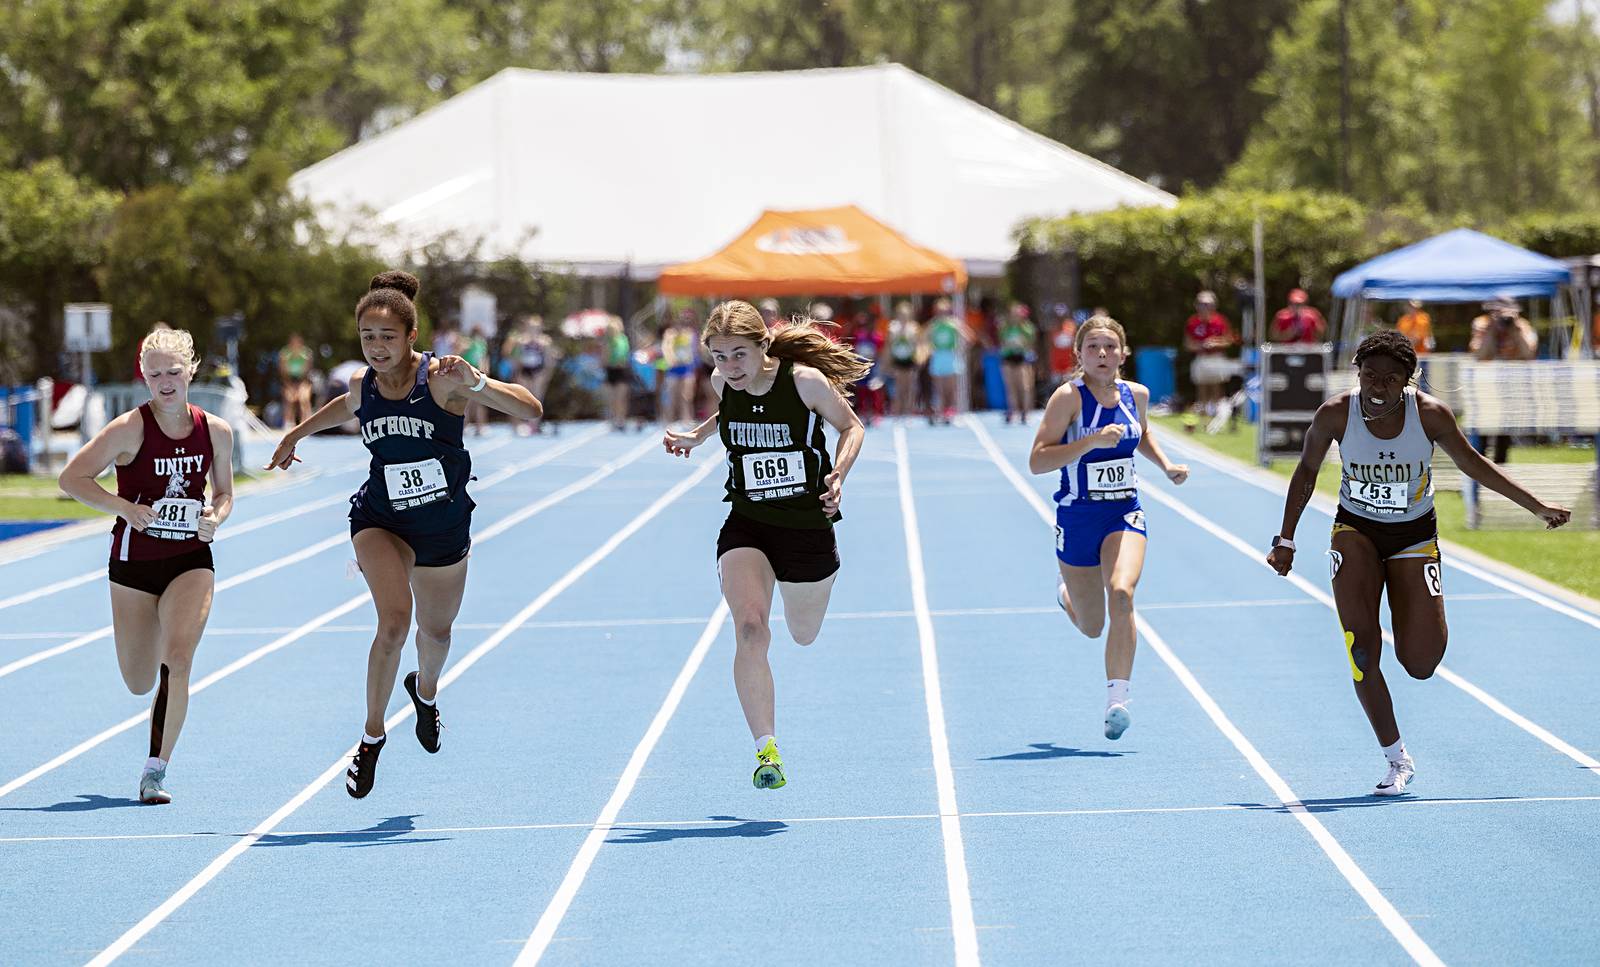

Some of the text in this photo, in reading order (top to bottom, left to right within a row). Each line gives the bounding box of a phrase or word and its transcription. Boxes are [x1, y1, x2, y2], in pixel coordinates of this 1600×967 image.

[728, 421, 793, 448] THUNDER
[154, 455, 204, 476] UNITY
[753, 457, 788, 479] 669
[1096, 466, 1124, 483] 708
[400, 469, 423, 489] 38
[422, 483, 437, 492] GIRLS
[1359, 481, 1392, 499] 753
[158, 504, 187, 522] 481
[1427, 564, 1441, 594] 8
